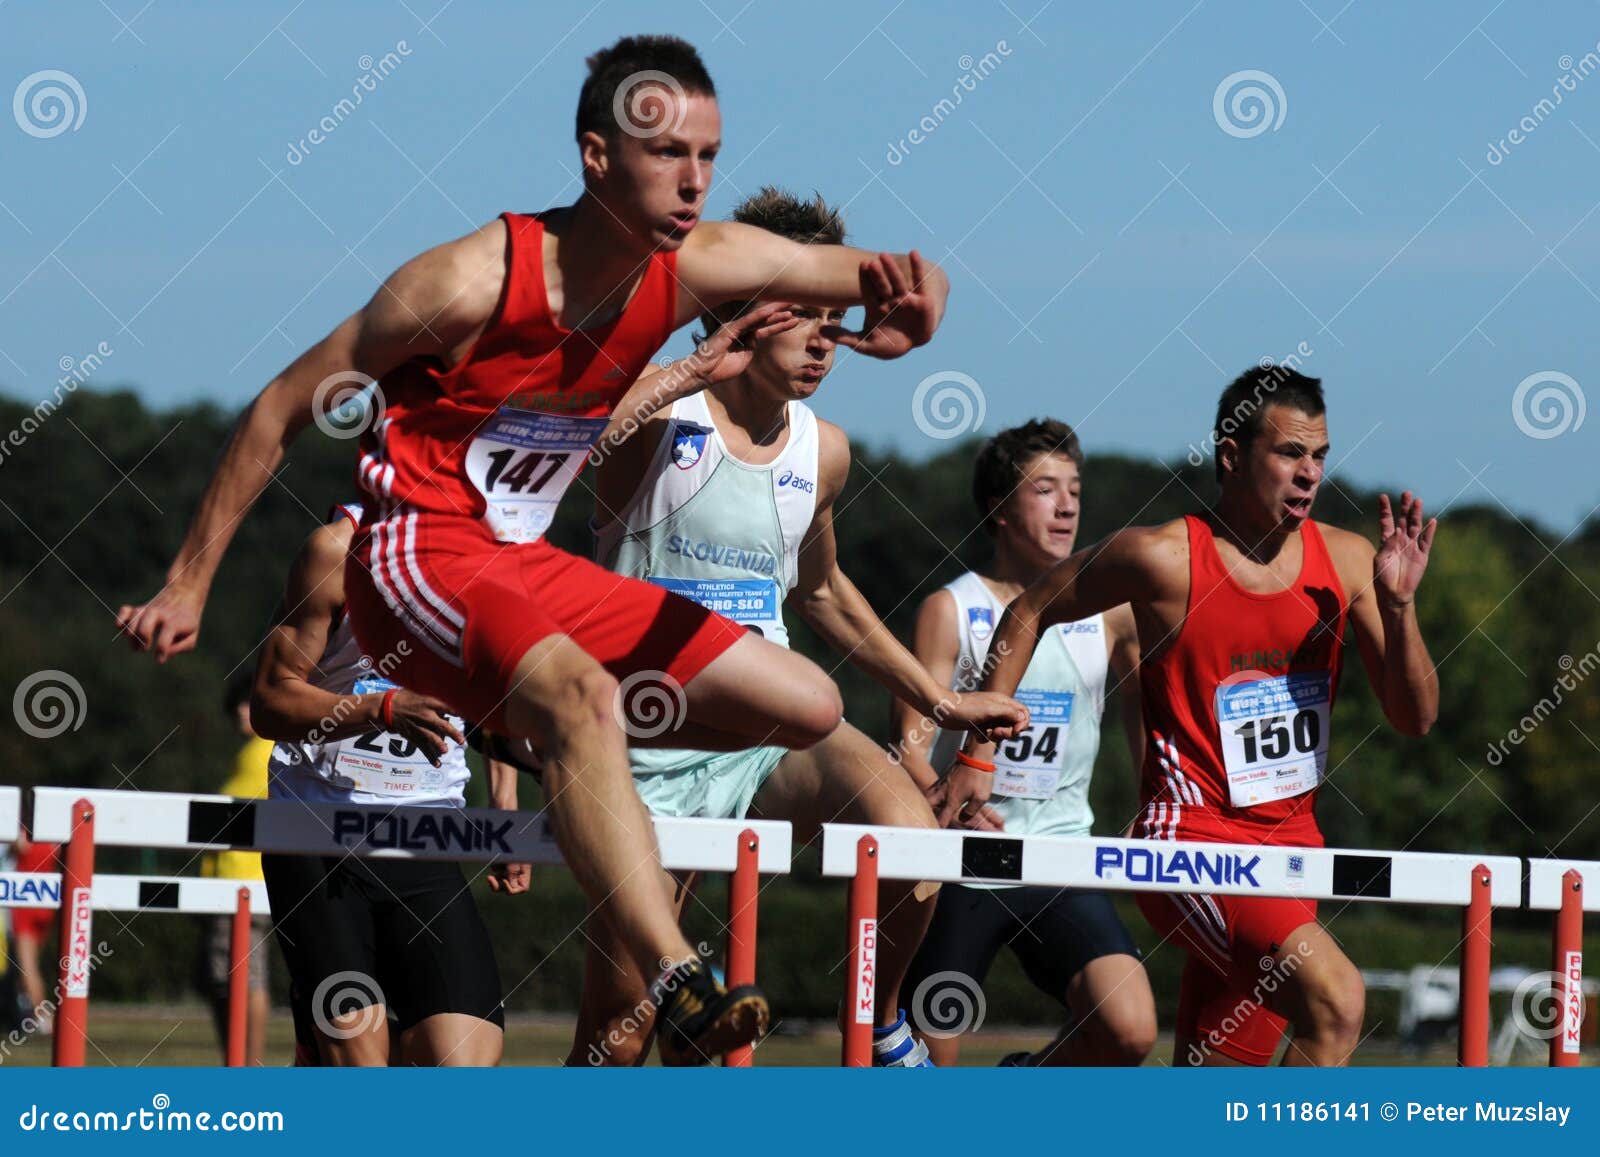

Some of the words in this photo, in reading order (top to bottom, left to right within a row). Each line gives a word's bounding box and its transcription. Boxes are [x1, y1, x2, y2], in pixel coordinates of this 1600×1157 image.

[485, 449, 571, 494] 147
[667, 534, 776, 576] SLOVENIJA
[994, 726, 1060, 764] 54
[1234, 709, 1320, 764] 150
[383, 781, 416, 791] TIMEX
[333, 810, 514, 853] POLANIK
[1095, 846, 1262, 888] POLANIK
[72, 893, 90, 984] POLANIK
[861, 923, 875, 1012] POLANIK
[1567, 955, 1581, 1042] POLANIK
